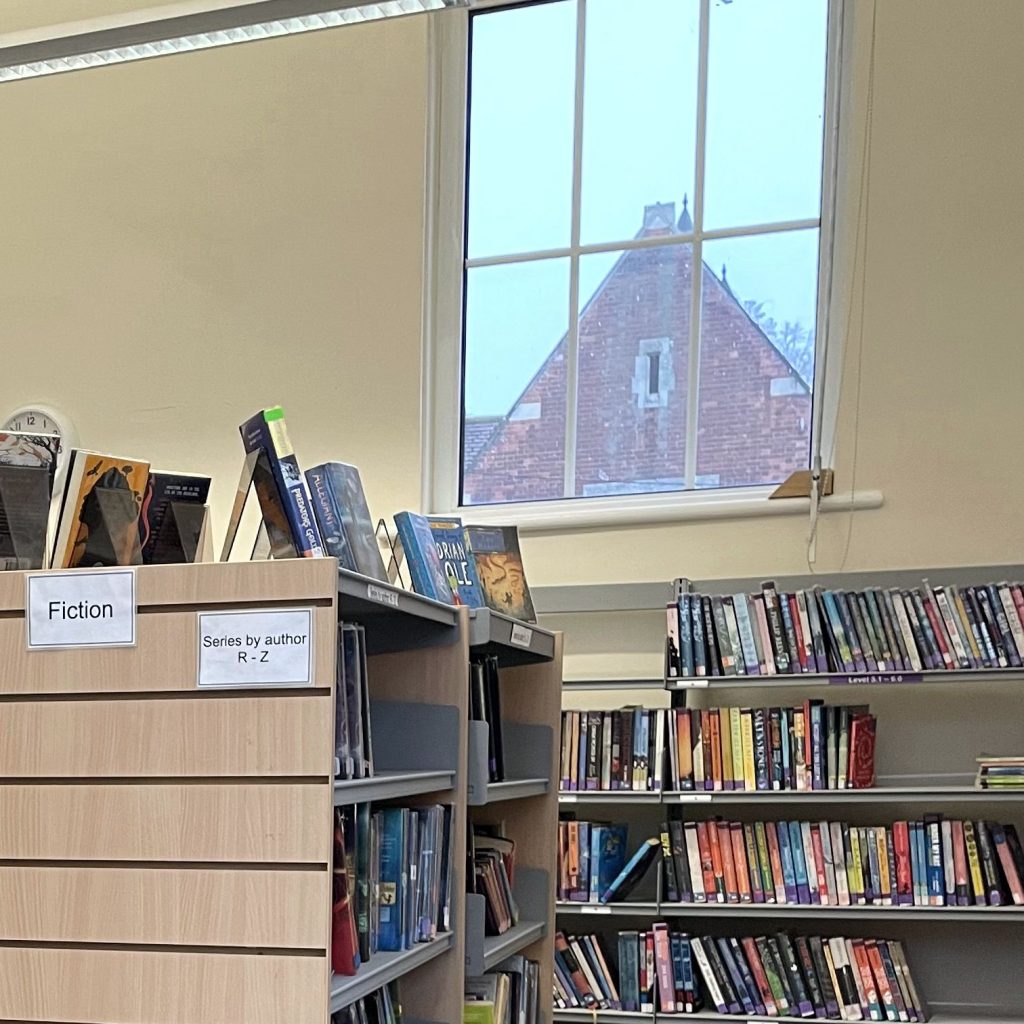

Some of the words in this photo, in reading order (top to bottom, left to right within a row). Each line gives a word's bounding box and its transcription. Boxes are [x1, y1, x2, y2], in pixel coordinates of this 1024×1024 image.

[26, 416, 36, 426] 12
[436, 541, 466, 561] DRIAN
[444, 561, 473, 586] OLE
[49, 600, 113, 620] Fiction
[203, 635, 242, 648] Series
[246, 635, 261, 648] by
[264, 633, 307, 646] author
[238, 651, 248, 663] R
[260, 651, 269, 663] Z
[848, 676, 870, 684] Level
